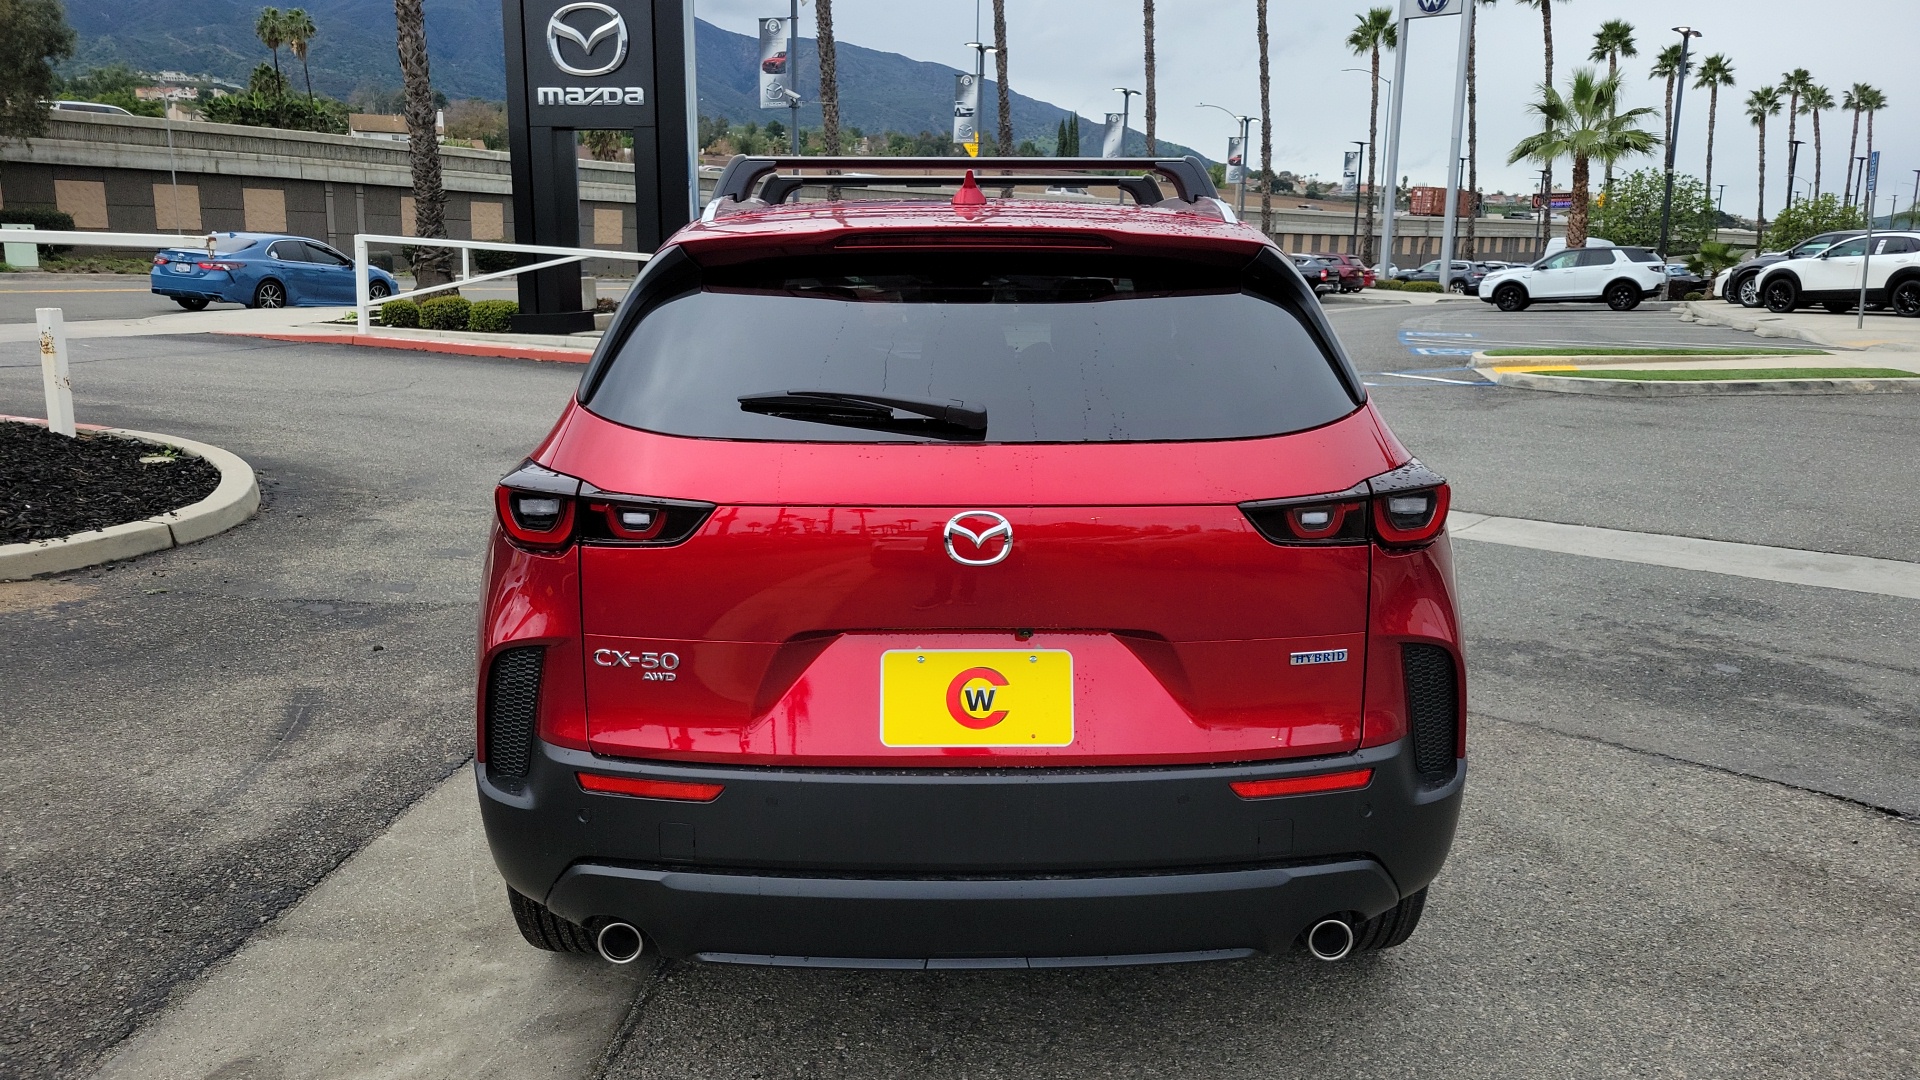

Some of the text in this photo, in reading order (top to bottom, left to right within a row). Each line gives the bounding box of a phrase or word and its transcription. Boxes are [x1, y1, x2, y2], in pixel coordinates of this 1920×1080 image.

[593, 648, 680, 670] CX-50
[1295, 651, 1345, 663] HYBRID
[642, 671, 677, 682] AWD
